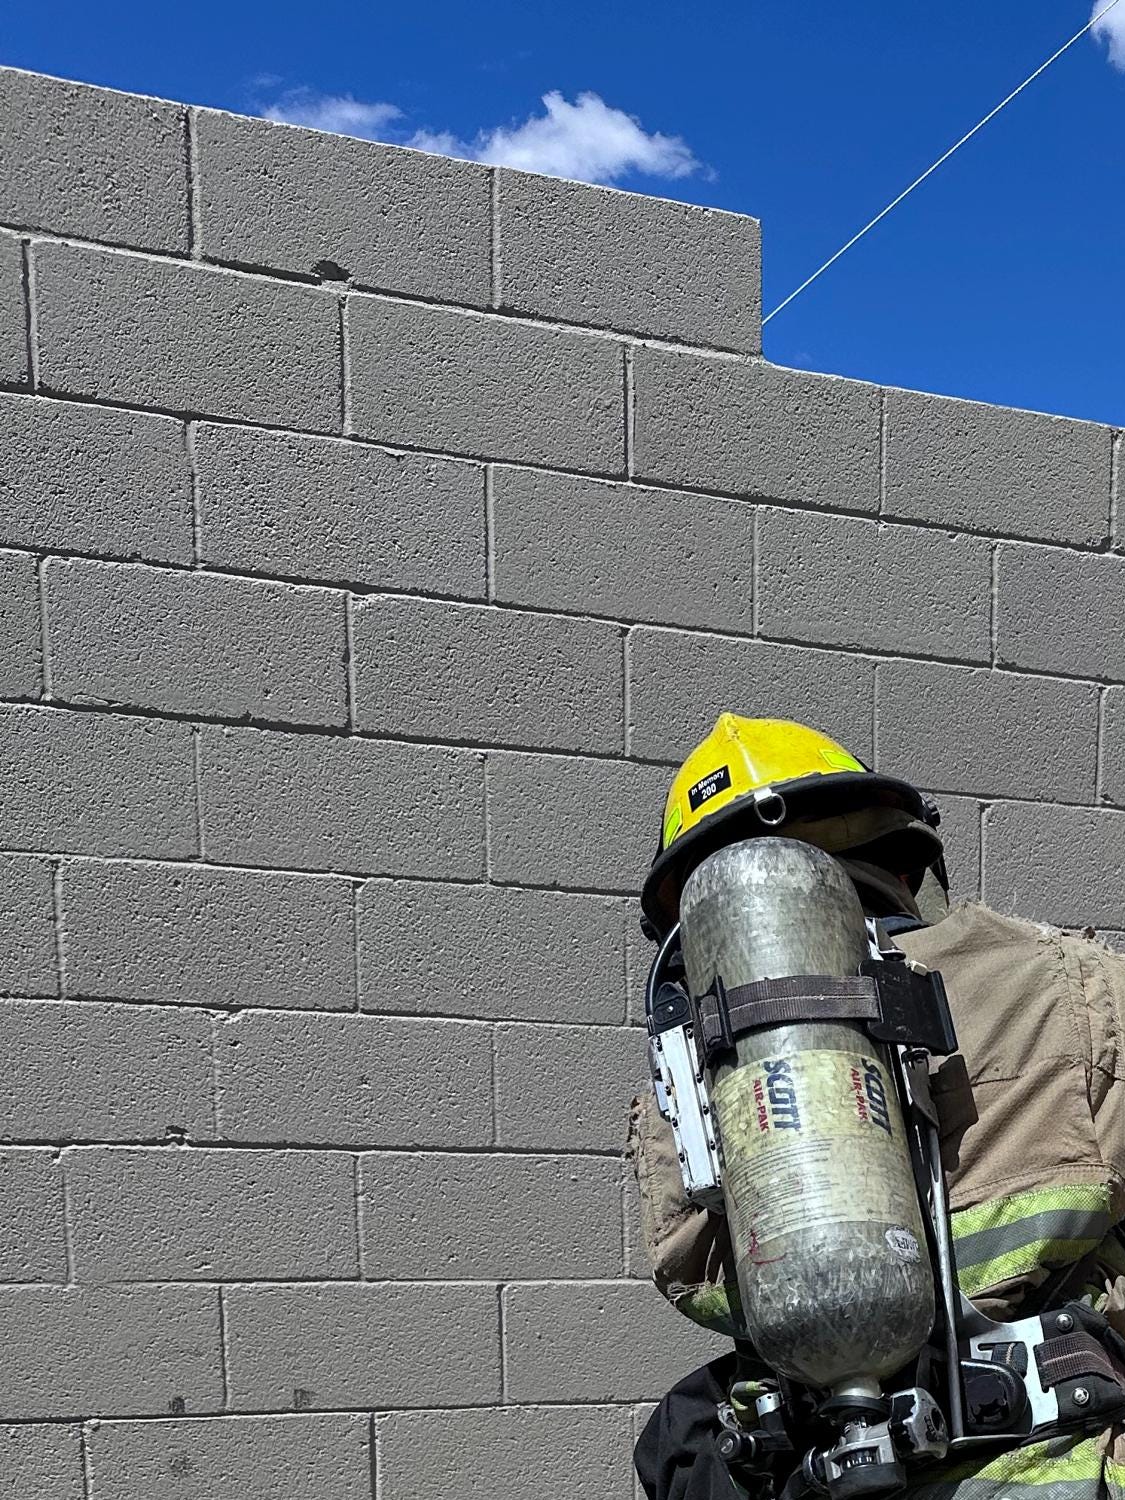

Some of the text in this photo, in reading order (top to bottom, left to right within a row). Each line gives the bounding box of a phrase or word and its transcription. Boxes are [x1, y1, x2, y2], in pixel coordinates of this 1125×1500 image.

[701, 783, 717, 800] 200
[753, 1078, 770, 1132] AIR-PAK
[764, 1058, 801, 1132] SCOTT
[850, 1067, 869, 1121] AIR-PAK
[861, 1058, 893, 1137] SCOTT
